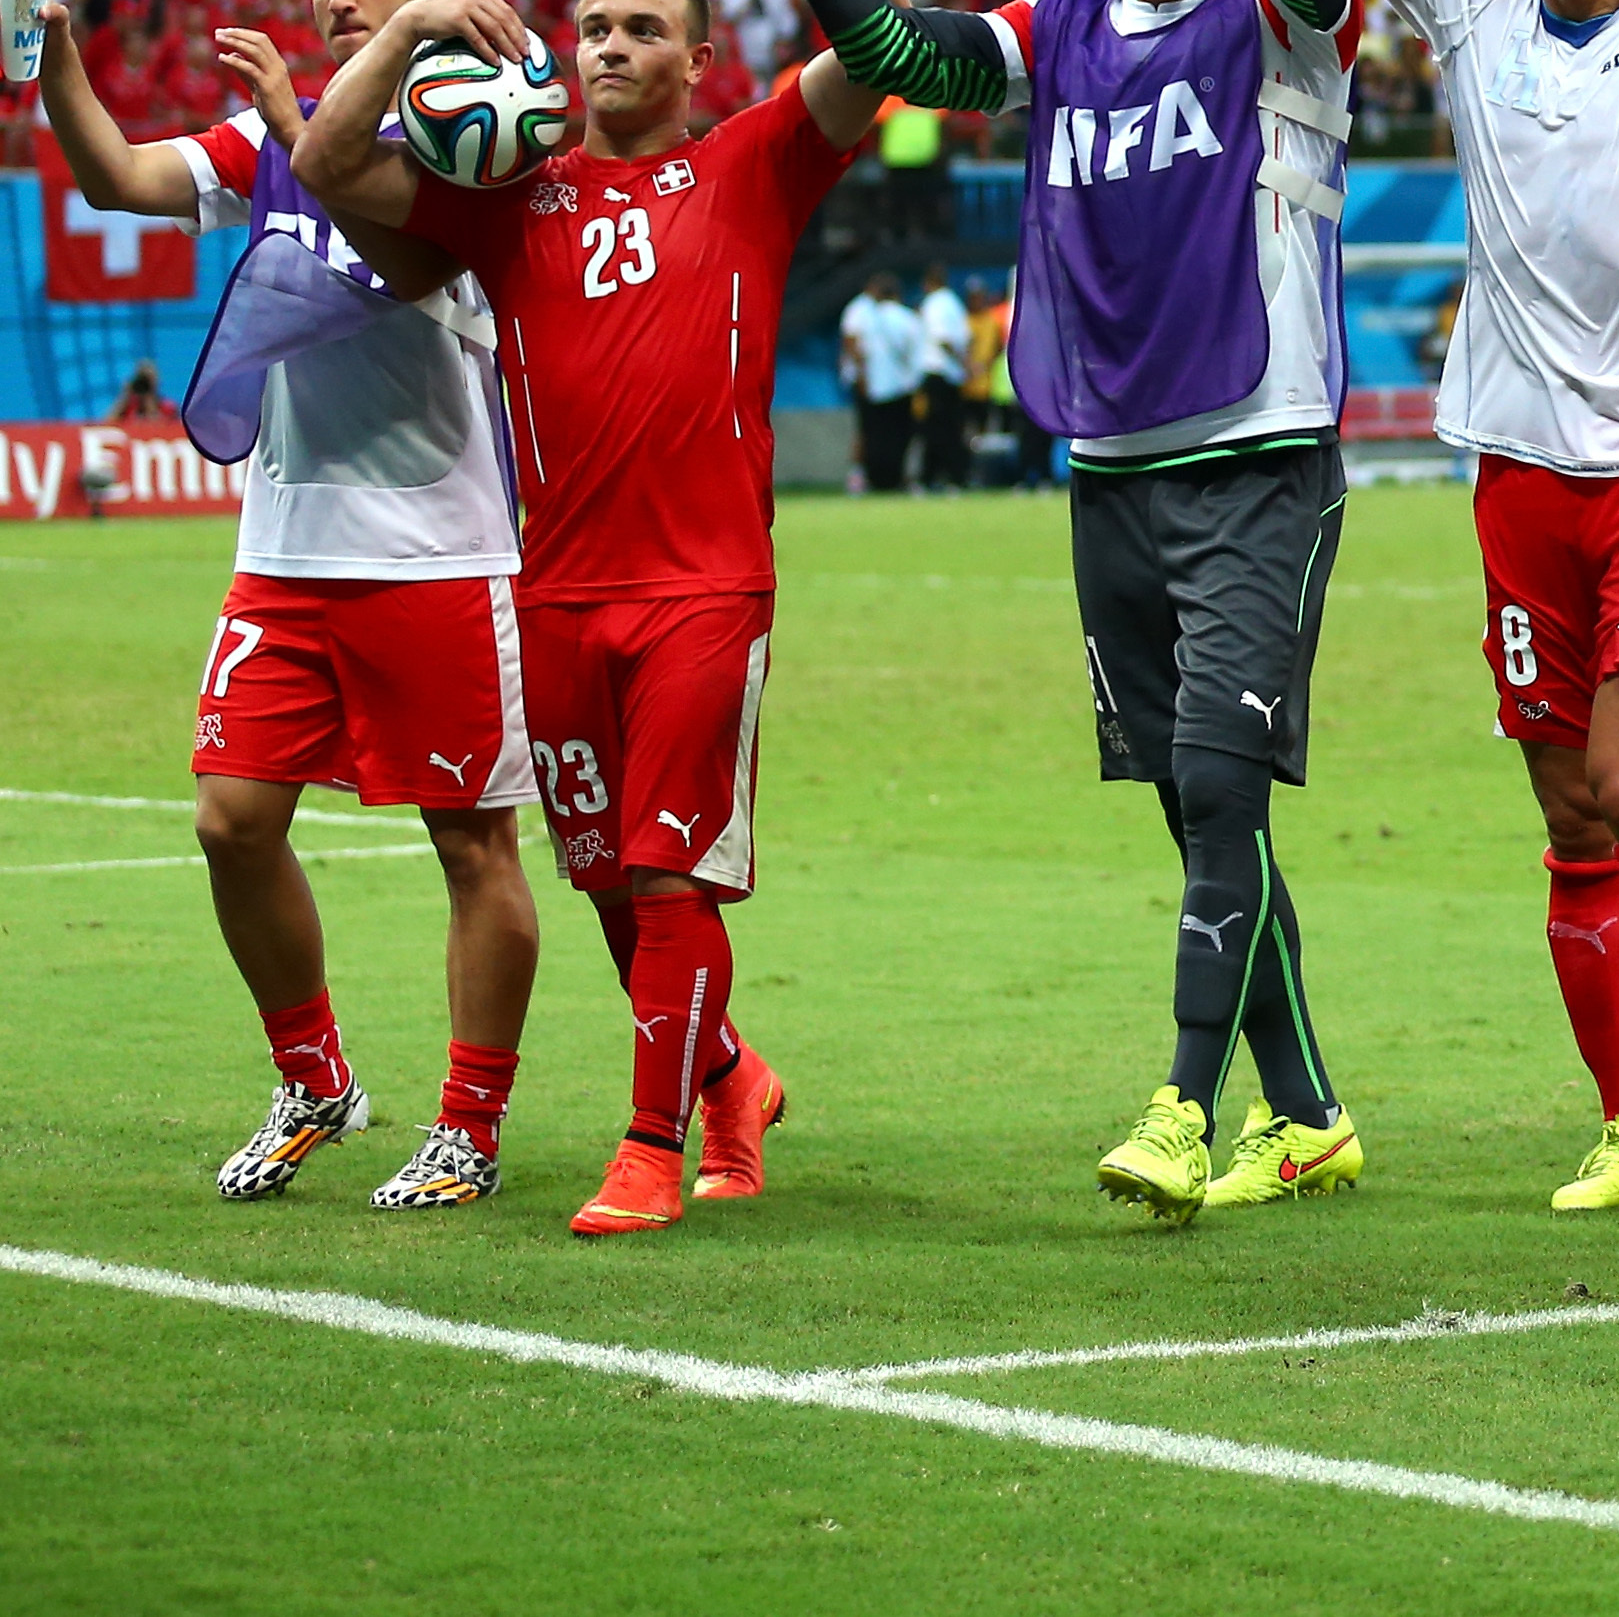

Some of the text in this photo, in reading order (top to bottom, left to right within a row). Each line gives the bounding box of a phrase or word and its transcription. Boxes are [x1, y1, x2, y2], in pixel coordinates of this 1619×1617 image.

[581, 207, 657, 299] 23
[200, 616, 264, 698] 17
[1501, 605, 1538, 686] 8
[533, 739, 609, 817] 23
